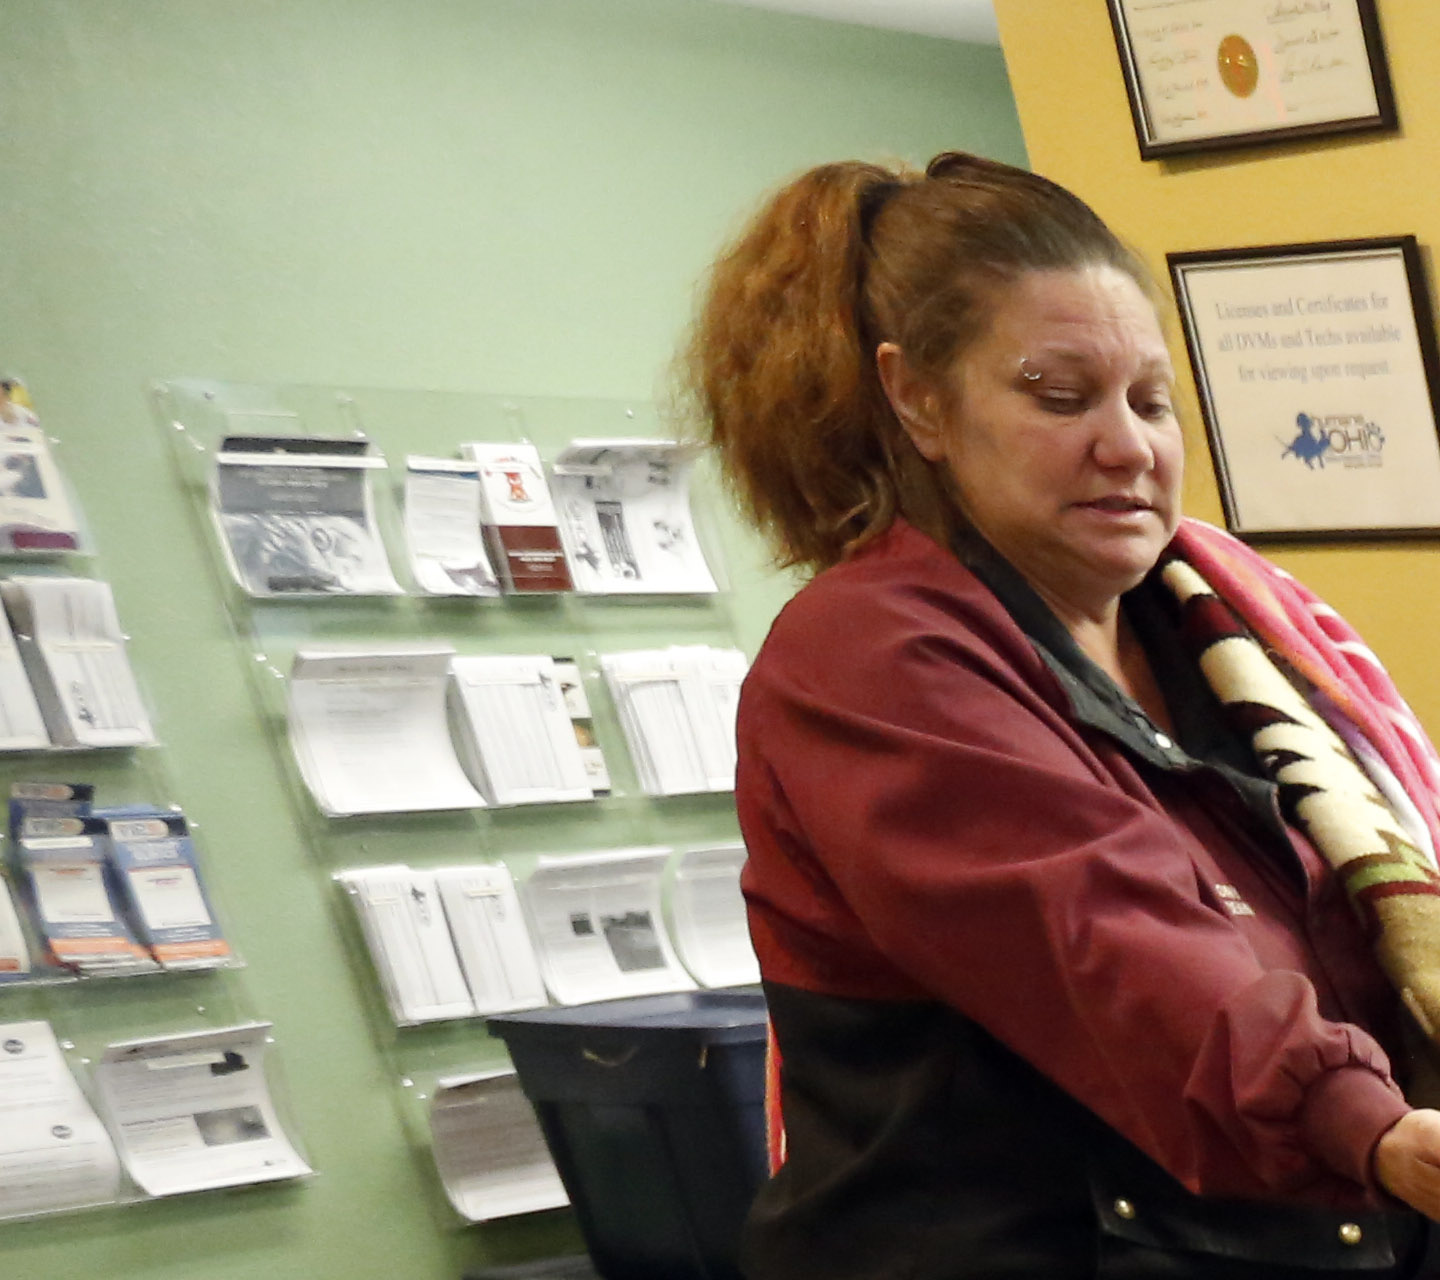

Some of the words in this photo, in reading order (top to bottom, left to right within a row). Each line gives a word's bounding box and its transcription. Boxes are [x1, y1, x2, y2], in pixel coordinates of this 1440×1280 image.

[1271, 297, 1294, 317] and
[1295, 294, 1369, 316] Certificates
[1370, 291, 1389, 312] for
[1344, 323, 1401, 345] available
